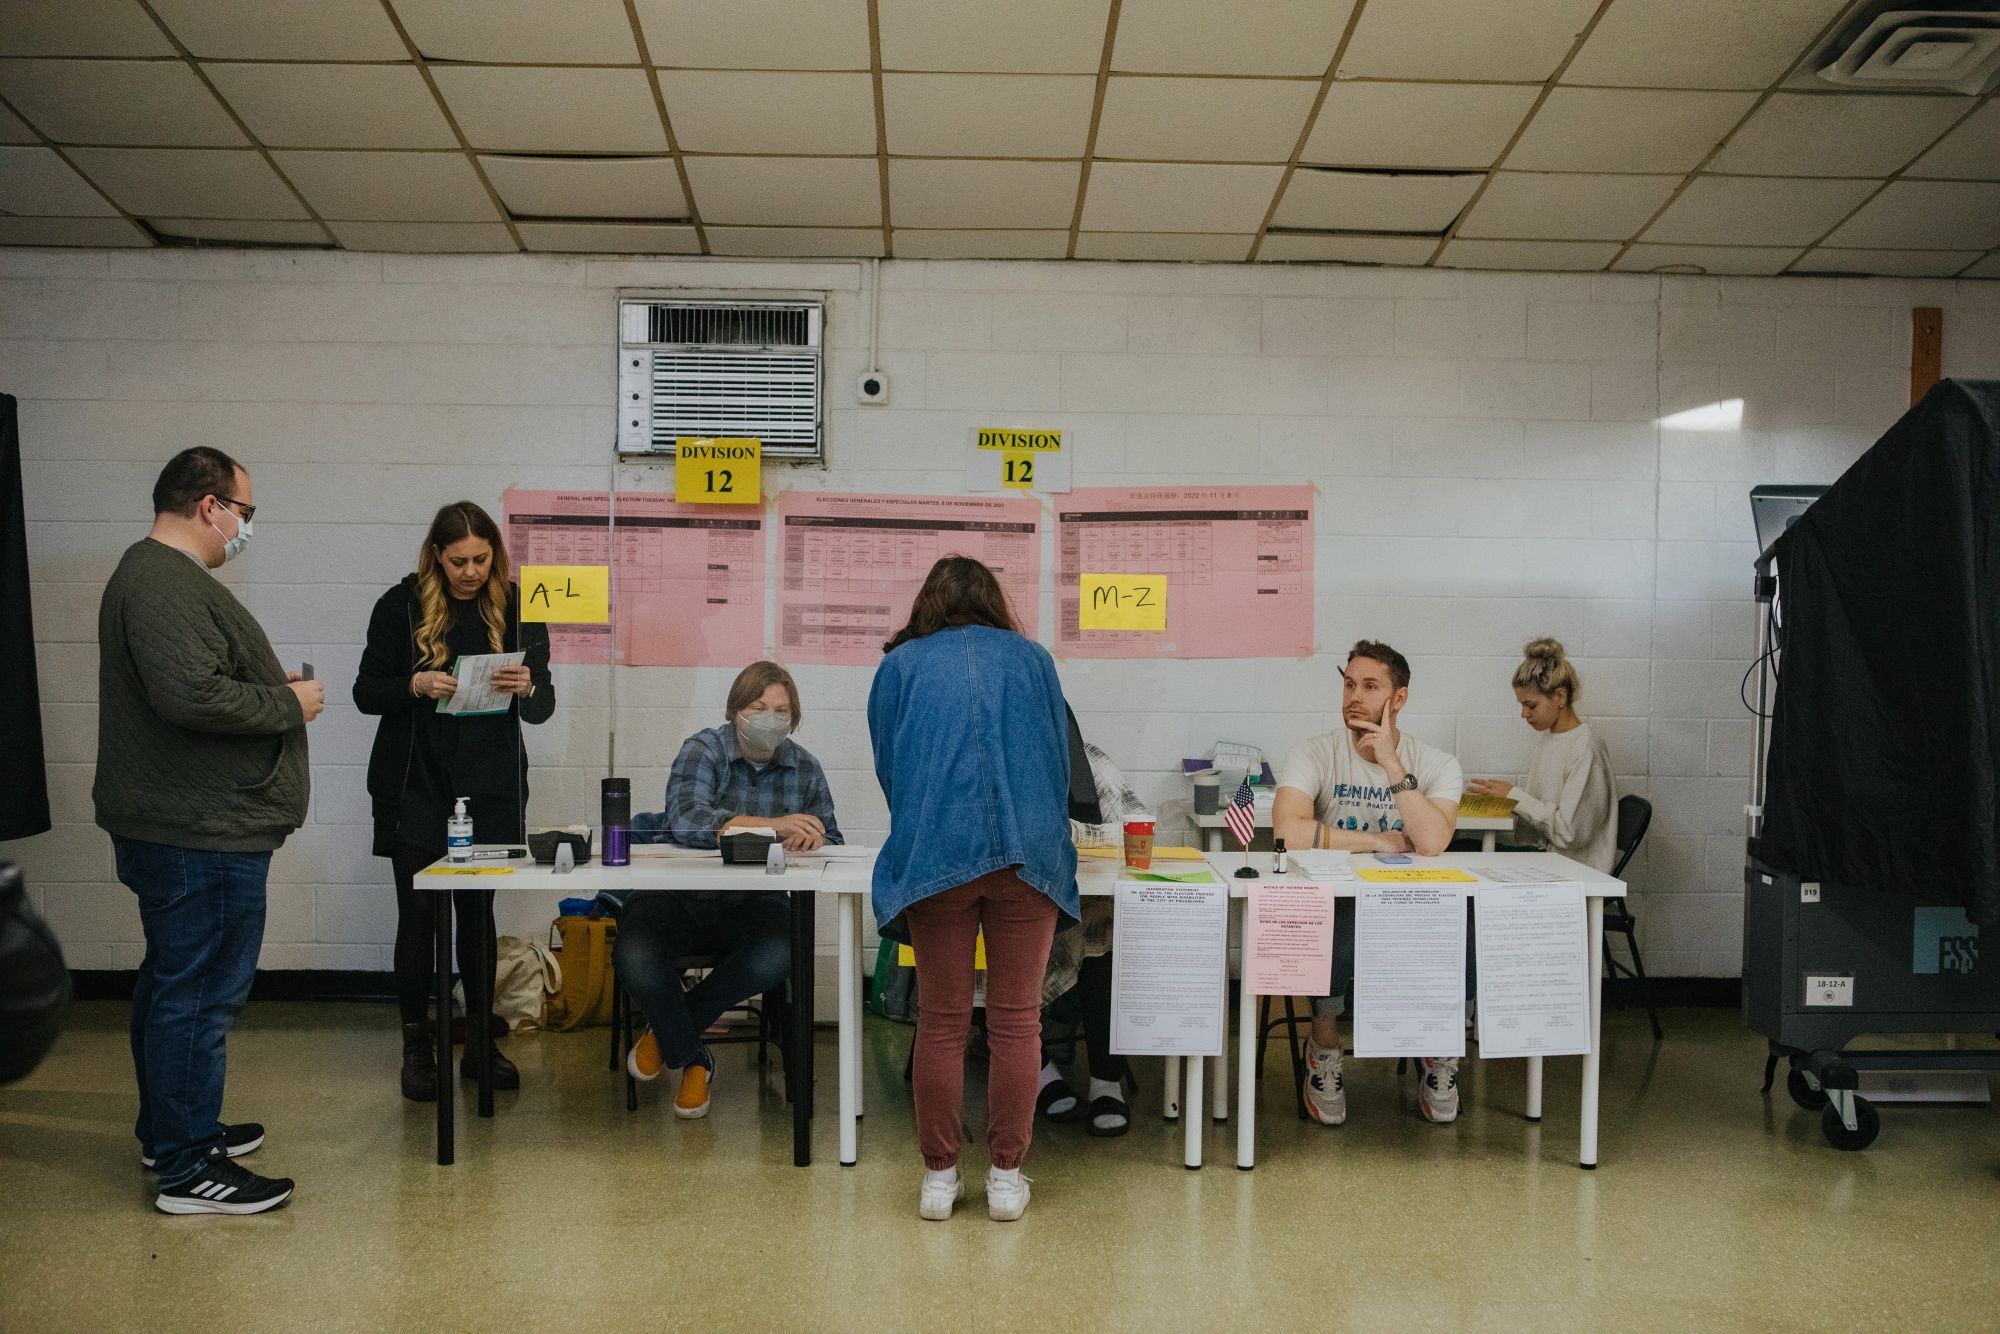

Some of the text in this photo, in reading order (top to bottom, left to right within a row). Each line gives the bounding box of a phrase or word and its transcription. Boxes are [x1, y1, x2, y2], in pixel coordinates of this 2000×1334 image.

[977, 432, 1062, 448] DIVISION
[681, 446, 756, 460] DIVISION
[703, 469, 734, 493] 12
[1003, 460, 1033, 483] 12
[528, 577, 581, 609] A-L
[1093, 585, 1156, 610] M-Z
[1816, 980, 1846, 988] 18-12-A
